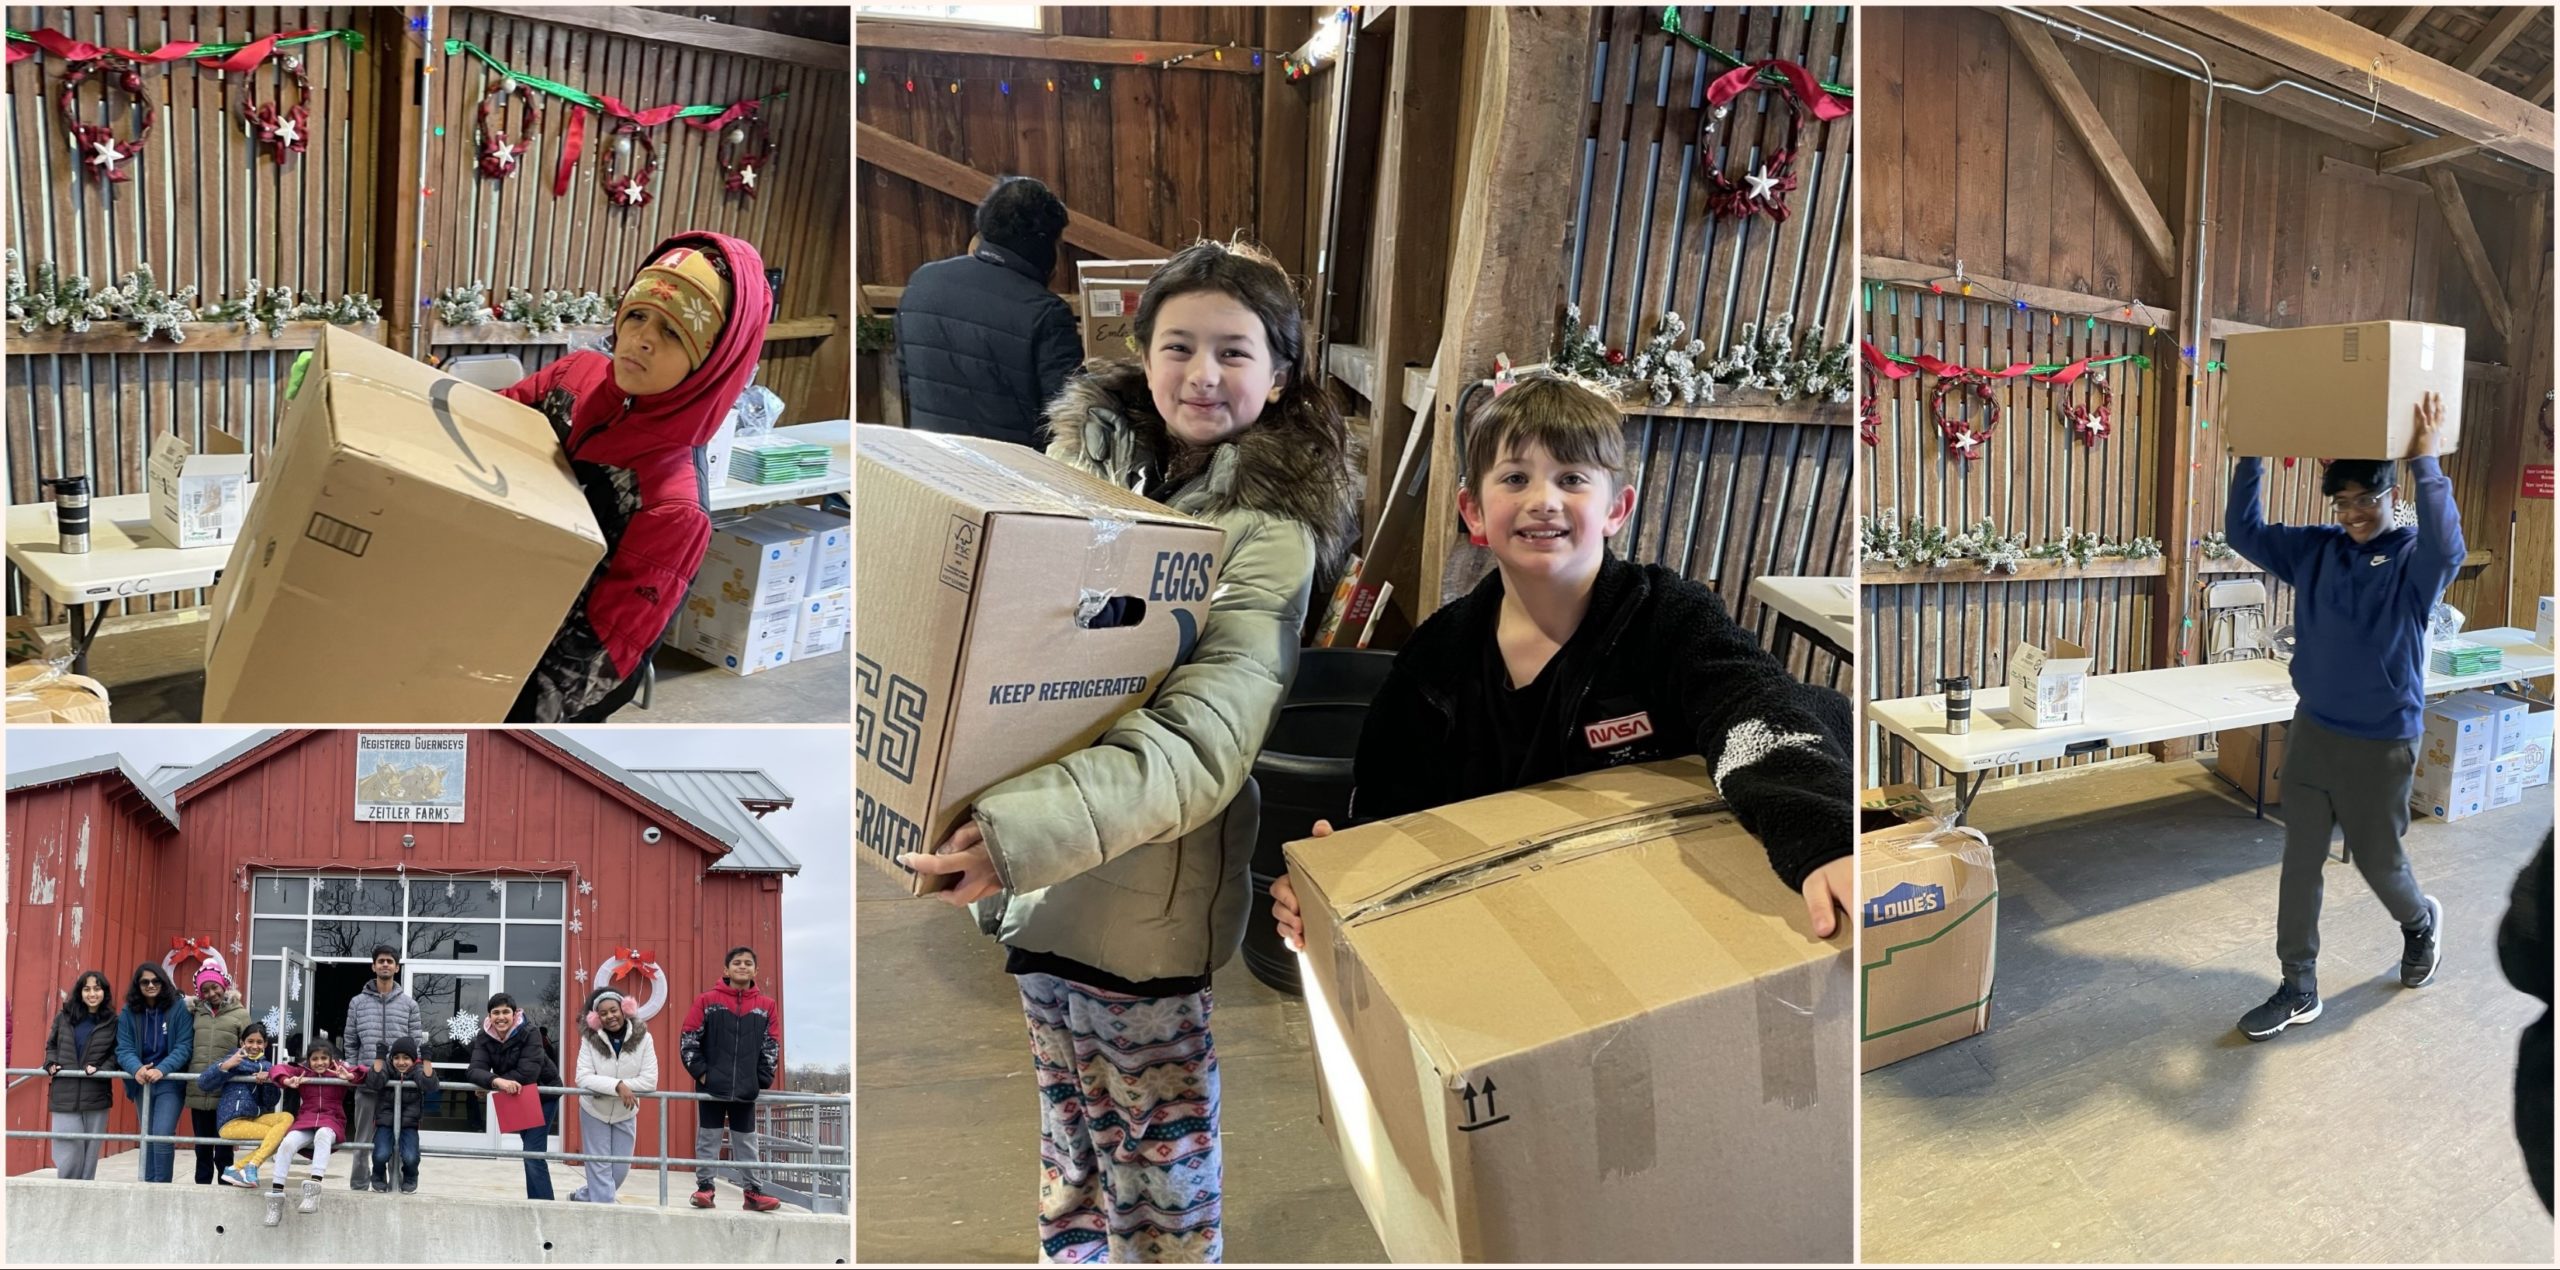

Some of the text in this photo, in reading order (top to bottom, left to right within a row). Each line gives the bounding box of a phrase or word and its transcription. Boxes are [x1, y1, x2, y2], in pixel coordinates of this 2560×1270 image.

[1149, 551, 1214, 602] EGGS
[1348, 588, 1370, 620] TEAM
[1359, 594, 1376, 619] LIFT
[989, 675, 1148, 705] KEEP REFRIGERATED
[360, 736, 464, 750] REGISTERED GUERNSEYS
[1588, 719, 1649, 745] NASA
[368, 806, 450, 821] ZEITLER FARMS
[1872, 892, 1938, 923] LOWE'S
